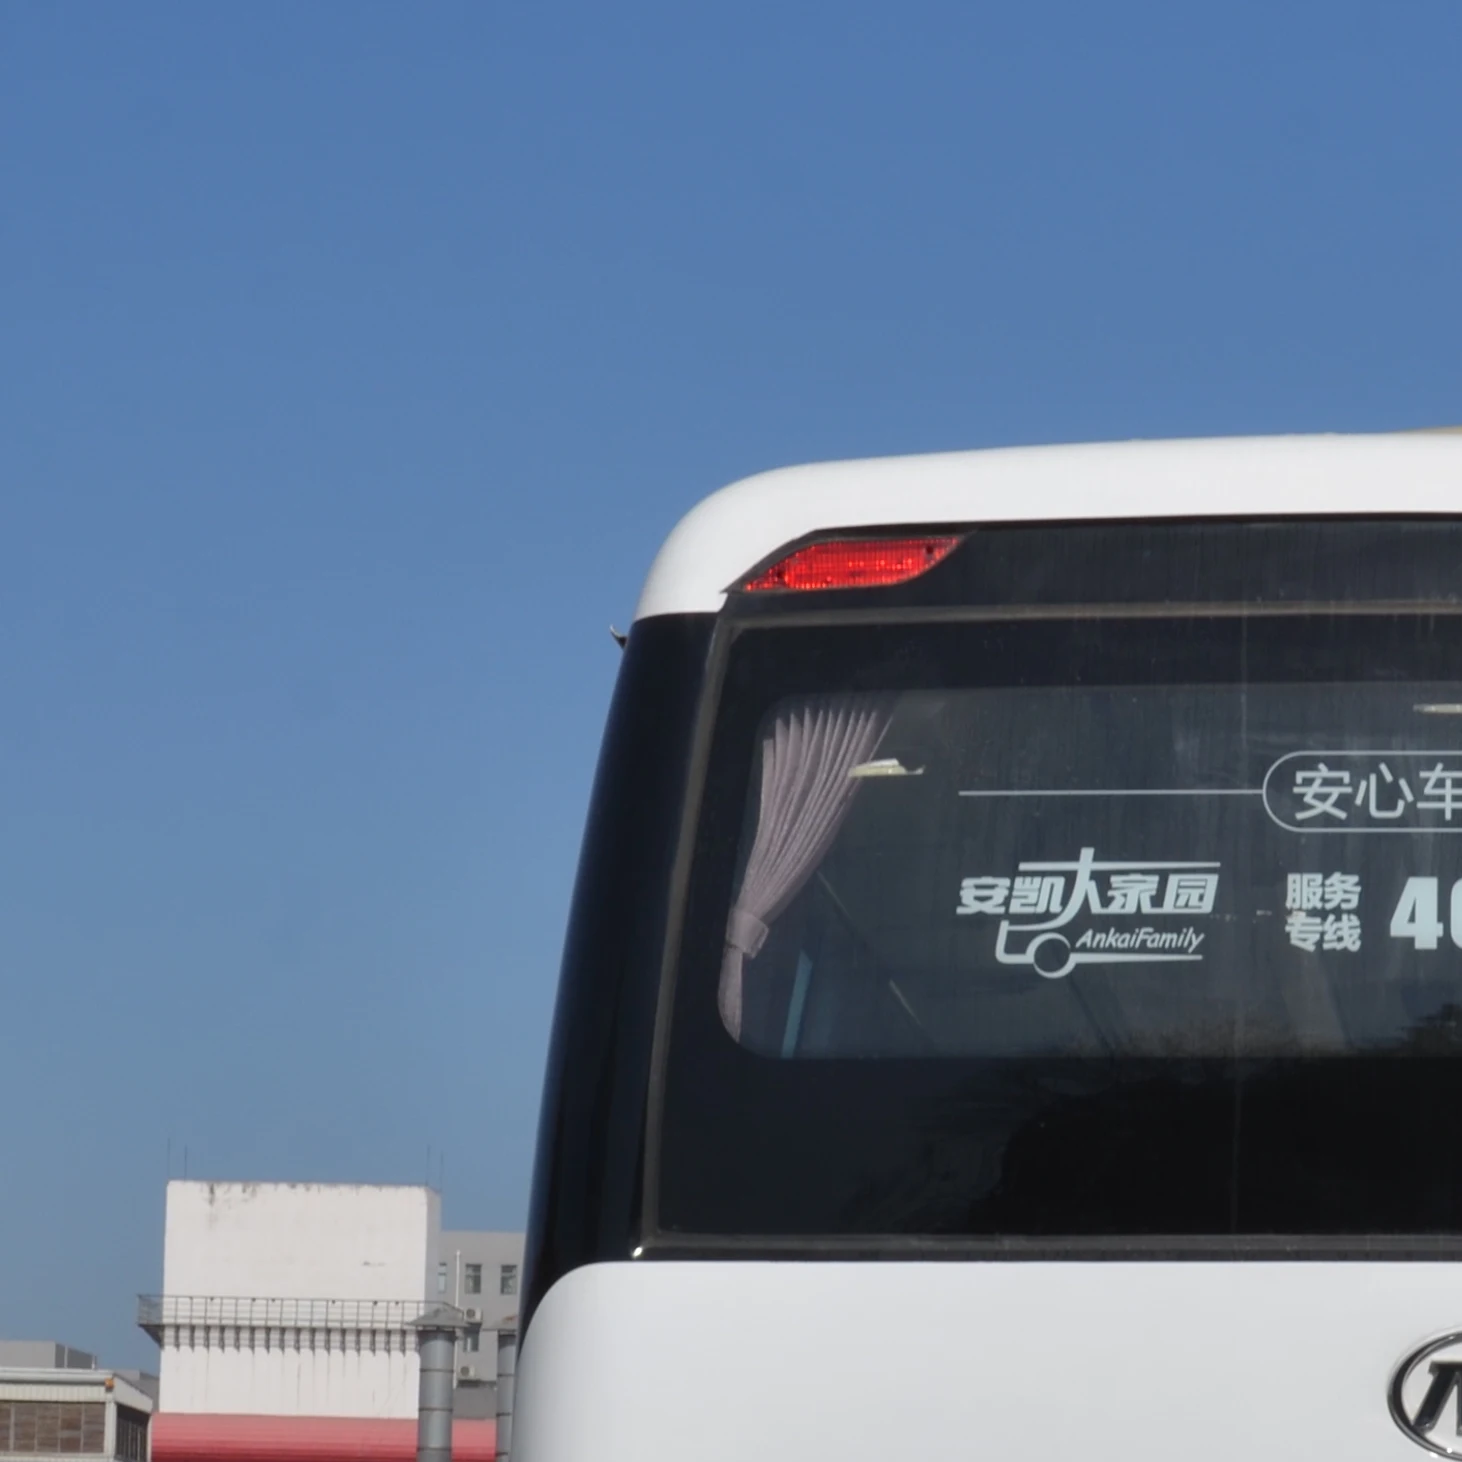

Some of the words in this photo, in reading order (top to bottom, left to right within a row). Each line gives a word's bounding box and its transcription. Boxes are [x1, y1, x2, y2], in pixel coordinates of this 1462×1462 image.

[955, 847, 1221, 932] 安凯大家园
[1285, 872, 1362, 911] 服务
[1074, 926, 1206, 954] AnkaiFamily
[1285, 911, 1362, 953] 专线
